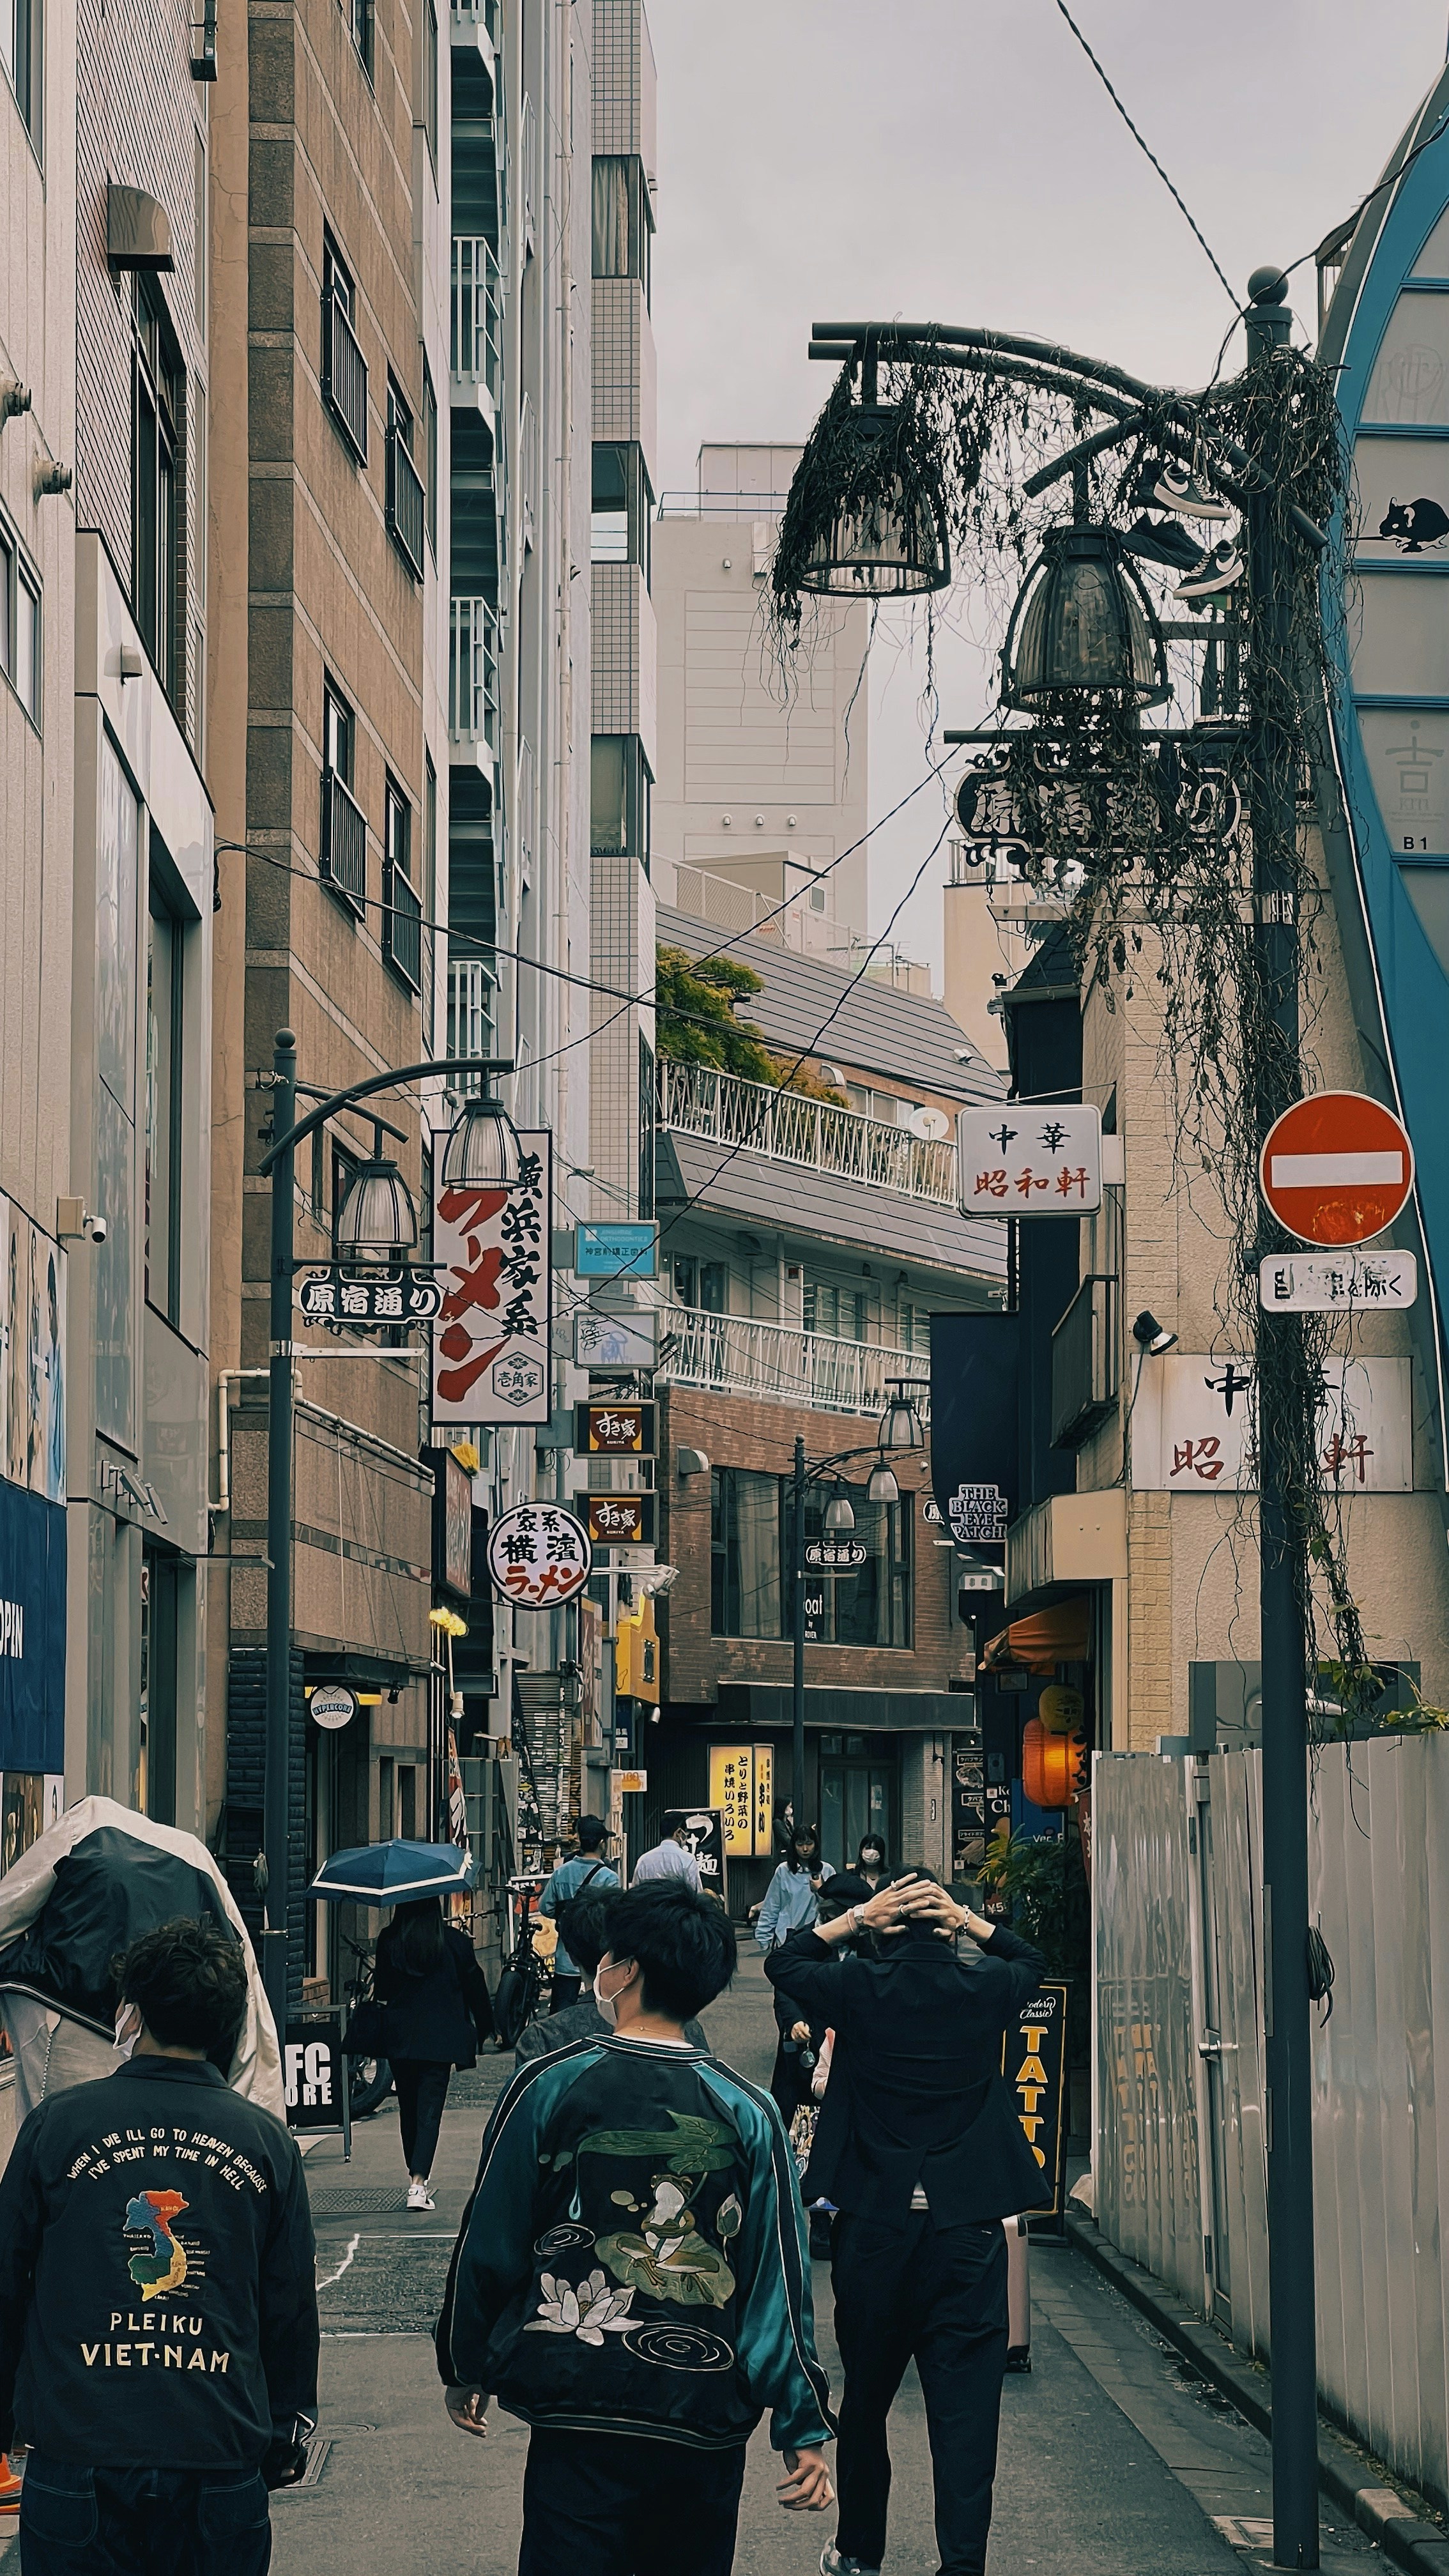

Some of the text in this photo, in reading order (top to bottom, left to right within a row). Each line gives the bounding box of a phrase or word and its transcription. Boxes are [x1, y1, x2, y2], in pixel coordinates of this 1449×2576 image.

[988, 1123, 1071, 1155] 中華
[974, 1167, 1090, 1199] 昭和軒
[306, 1284, 436, 1315] 原宿通り
[497, 1371, 539, 1388] 壱角家
[595, 1411, 636, 1439] すき家
[1170, 1432, 1374, 1484] 昭軒
[953, 1500, 1003, 1513] BLACK
[962, 1488, 994, 1500] THE
[595, 1501, 636, 1529] すき家
[963, 1513, 993, 1526] EYE
[953, 1526, 1002, 1538] PATCH
[809, 1548, 863, 1562] 原宿通り
[505, 1565, 585, 1603] ラーメン
[312, 1703, 352, 1715] HYPERCORE
[724, 1763, 735, 1841] 串焼いろいろ
[737, 1756, 749, 1829] とりと野菜の
[1020, 2009, 1053, 2020] Classic
[1027, 1997, 1056, 2009] odern
[66, 2128, 267, 2193] WHEN I DIE ILL GO TO HEAVEN BECAUSE
[88, 2145, 245, 2191] I'VE SPENT MY TIME IN HELL
[110, 2312, 203, 2336] PLEIKU
